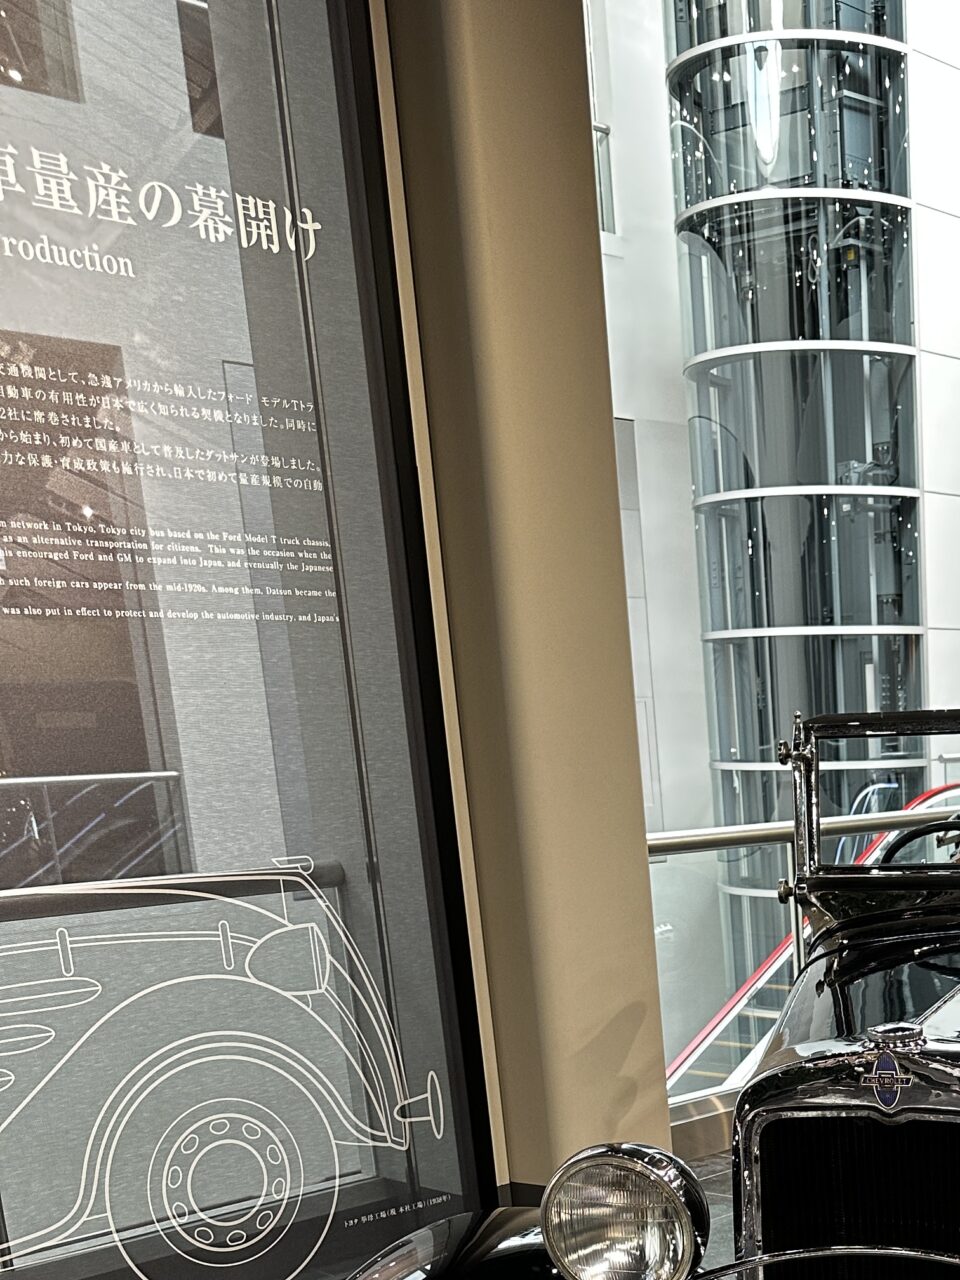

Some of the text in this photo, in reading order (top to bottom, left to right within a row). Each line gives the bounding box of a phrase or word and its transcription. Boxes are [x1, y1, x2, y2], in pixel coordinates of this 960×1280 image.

[0, 235, 136, 278] roduction
[10, 519, 49, 530] network
[99, 524, 126, 536] Tokyo
[129, 526, 146, 537] city
[167, 528, 191, 538] based
[206, 531, 219, 540] the
[222, 531, 241, 542] Ford
[279, 535, 300, 545] truck
[32, 535, 82, 546] alternative
[85, 537, 148, 551] transportation
[151, 541, 163, 550] for
[207, 544, 226, 554] This
[229, 547, 244, 555] was
[247, 546, 260, 555] the
[263, 547, 294, 557] occasion
[297, 548, 317, 558] when
[320, 549, 332, 559] the
[0, 547, 14, 556] his
[16, 548, 69, 561] encouraged
[72, 551, 94, 560] Ford
[98, 552, 113, 561] and
[146, 554, 176, 566] expand
[179, 556, 196, 566] into
[226, 558, 240, 568] and
[244, 559, 283, 571] eventually
[286, 561, 298, 571] the
[301, 562, 333, 574] Japanese
[8, 576, 30, 586] such
[33, 577, 66, 588] foreign
[92, 582, 122, 590] appear
[125, 580, 146, 590] from
[148, 581, 163, 591] the
[211, 584, 239, 595] Among
[265, 586, 292, 596] Datsun
[294, 587, 321, 597] became
[324, 588, 336, 597] the
[23, 605, 42, 615] also
[45, 606, 61, 616] put
[75, 606, 101, 616] effect
[115, 607, 146, 618] protect
[148, 608, 164, 617] and
[167, 608, 198, 619] develop
[200, 609, 214, 619] the
[298, 612, 311, 621] and
[313, 612, 339, 623] Japan's
[866, 1077, 908, 1085] CHEVROLET
